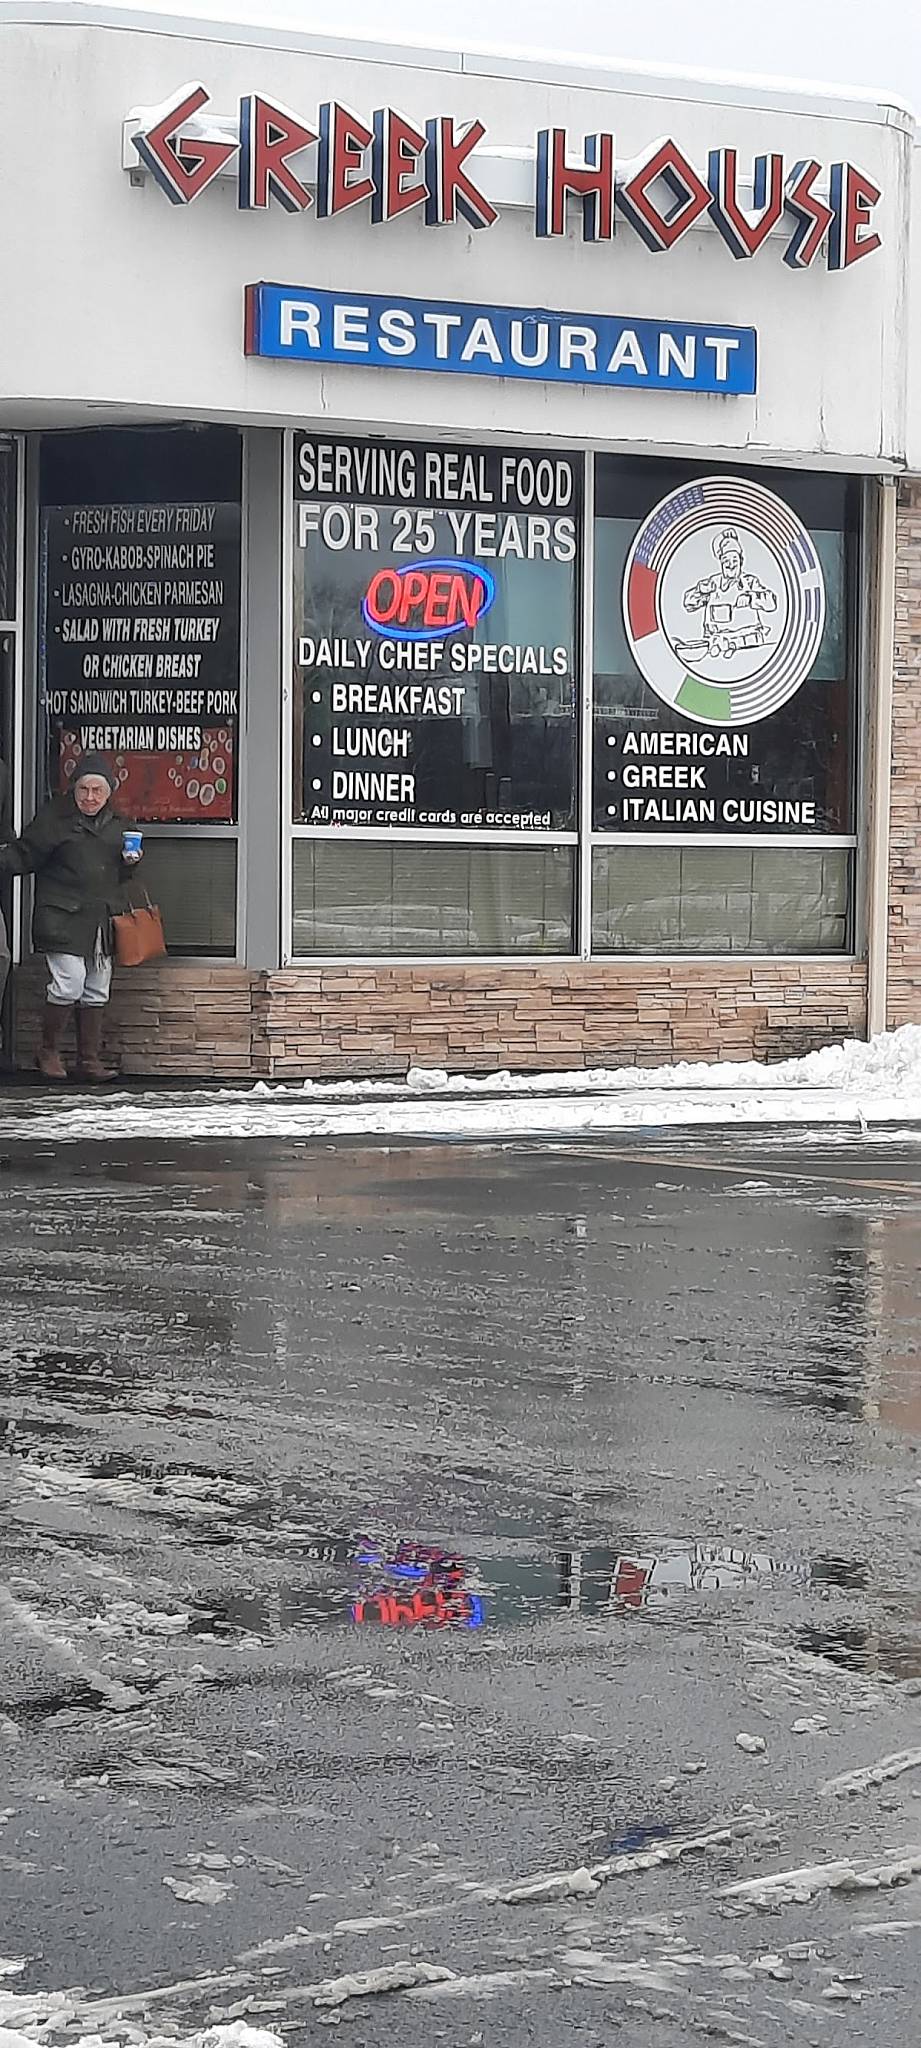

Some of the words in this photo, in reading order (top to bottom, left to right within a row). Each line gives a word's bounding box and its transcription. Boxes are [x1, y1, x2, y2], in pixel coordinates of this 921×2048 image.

[131, 84, 500, 230] GREEK
[536, 124, 884, 271] HOUSE
[278, 298, 740, 382] RESTAURANT
[299, 442, 416, 498] SERVING
[424, 451, 493, 502] REAL
[501, 457, 572, 507] FOOD
[72, 510, 108, 534] FRESH
[110, 509, 136, 533] FISH
[137, 508, 174, 532] EVERY
[175, 507, 216, 532] FRIDAY
[298, 503, 379, 552] FOR
[391, 509, 436, 554] 25
[446, 512, 576, 561] YEARS
[197, 544, 214, 568] PIE
[164, 580, 223, 605] PARMESAN
[364, 567, 484, 628] OPEN
[62, 618, 99, 642] SALAD
[102, 618, 131, 641] WITH
[133, 618, 171, 641] FRESH
[174, 617, 220, 641] TURKEY
[83, 654, 99, 678] OR
[102, 654, 153, 678] CHICKEN
[155, 654, 201, 678] BREAST
[298, 637, 372, 671] DAILY
[379, 641, 444, 672] CHEF
[450, 643, 568, 675] SPECIALS
[46, 690, 68, 714] HOT
[70, 690, 127, 714] SANDWICH
[207, 690, 237, 714] PORK
[332, 683, 465, 716] BREAKFAST
[80, 726, 154, 750] VEGETARIAN
[157, 726, 201, 750] DISHES
[332, 728, 409, 757] LUNCH
[622, 732, 748, 756] AMERICAN
[332, 771, 415, 803] DINNER
[622, 765, 706, 789] GREEK
[311, 805, 329, 819] All
[332, 808, 373, 824] major
[376, 808, 415, 822] credit
[419, 809, 456, 824] cards
[461, 811, 482, 825] are
[486, 810, 550, 829] accepted
[622, 798, 715, 822] ITALIAN
[722, 800, 815, 824] CUISINE
